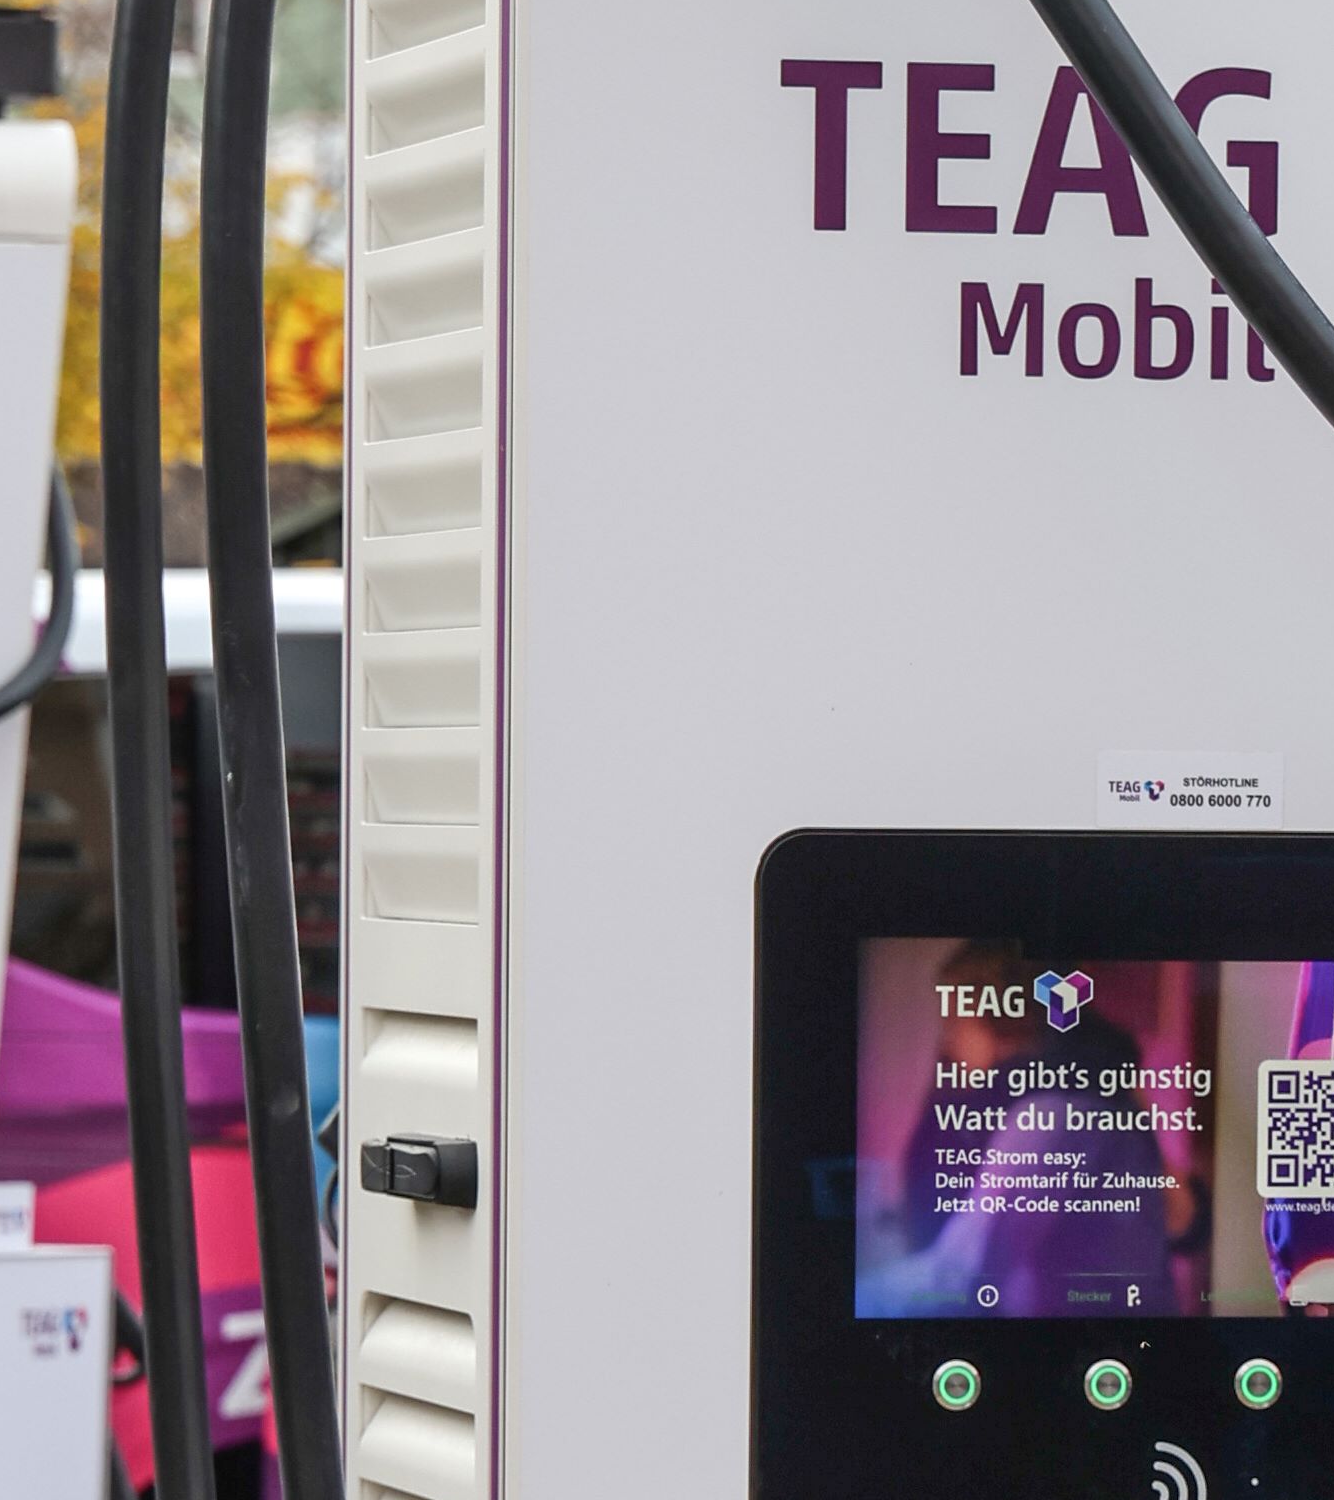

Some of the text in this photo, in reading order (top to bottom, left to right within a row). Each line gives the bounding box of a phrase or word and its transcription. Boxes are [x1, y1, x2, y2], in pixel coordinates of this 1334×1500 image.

[780, 59, 1279, 238] TEAG
[1108, 780, 1141, 793] TEAG
[1182, 776, 1259, 788] STÖRHOTLINE
[1170, 794, 1272, 808] 0800 6000 770
[935, 985, 1025, 1018] TEAG
[935, 1061, 999, 1089] Hier
[1099, 1062, 1212, 1097] günstig
[934, 1103, 1203, 1131] Watt du brauchst.
[935, 1149, 1087, 1169] TEAG.Strom easy:
[935, 1172, 1181, 1188] Dein Stromtarif für Zuhause.
[934, 1196, 1141, 1214] Jetzt QR-Code scannen!
